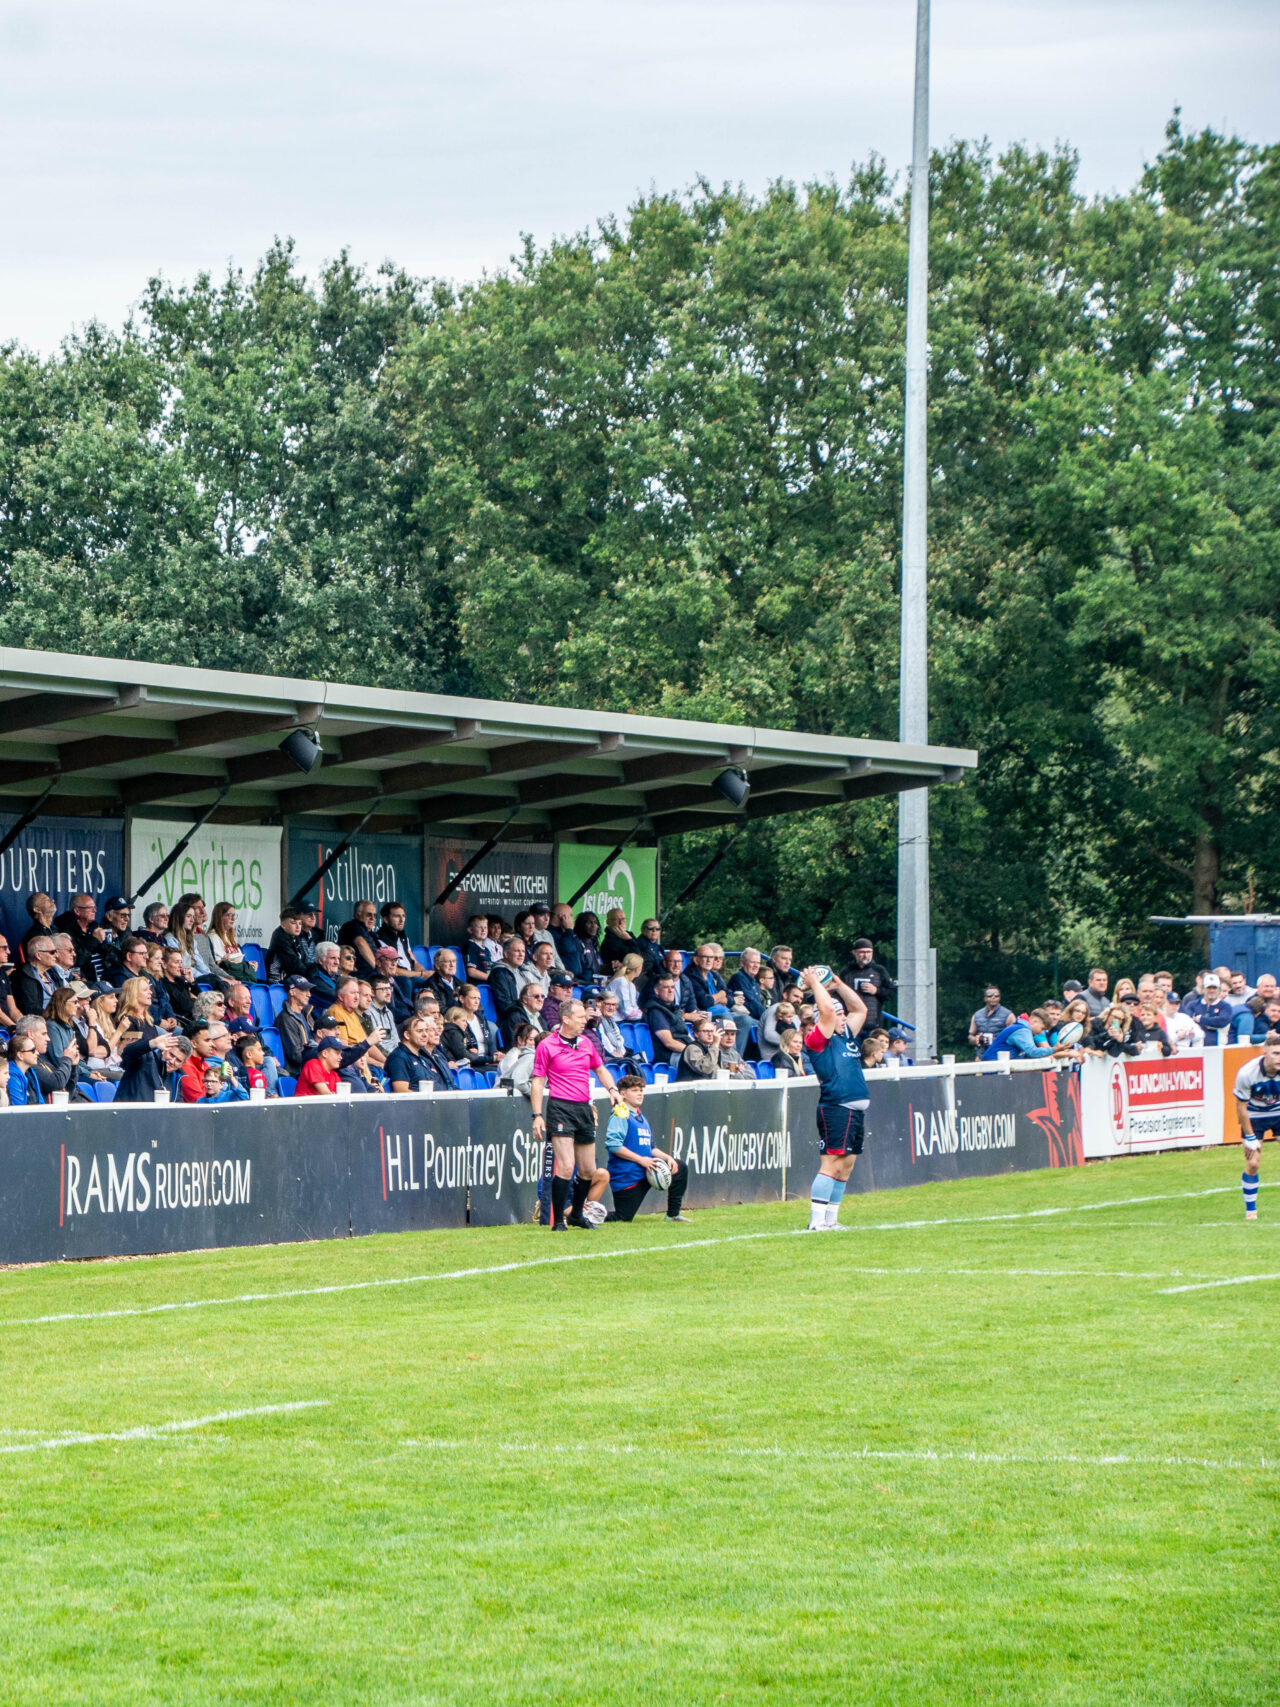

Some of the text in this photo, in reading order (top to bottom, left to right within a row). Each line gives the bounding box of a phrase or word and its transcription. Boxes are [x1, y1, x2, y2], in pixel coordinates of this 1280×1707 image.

[157, 837, 263, 911] Veritas
[325, 846, 397, 902] Stillman
[513, 876, 549, 894] KITCHEN
[597, 892, 624, 915] Class
[1128, 1070, 1203, 1095] DUNCAN-LYNCH
[960, 1113, 1016, 1152] RUGBY.COM
[1129, 1117, 1161, 1134] Precision
[155, 1159, 251, 1210] RUGBY.COM
[386, 1134, 420, 1192] H.L
[424, 1133, 506, 1200] Pountney
